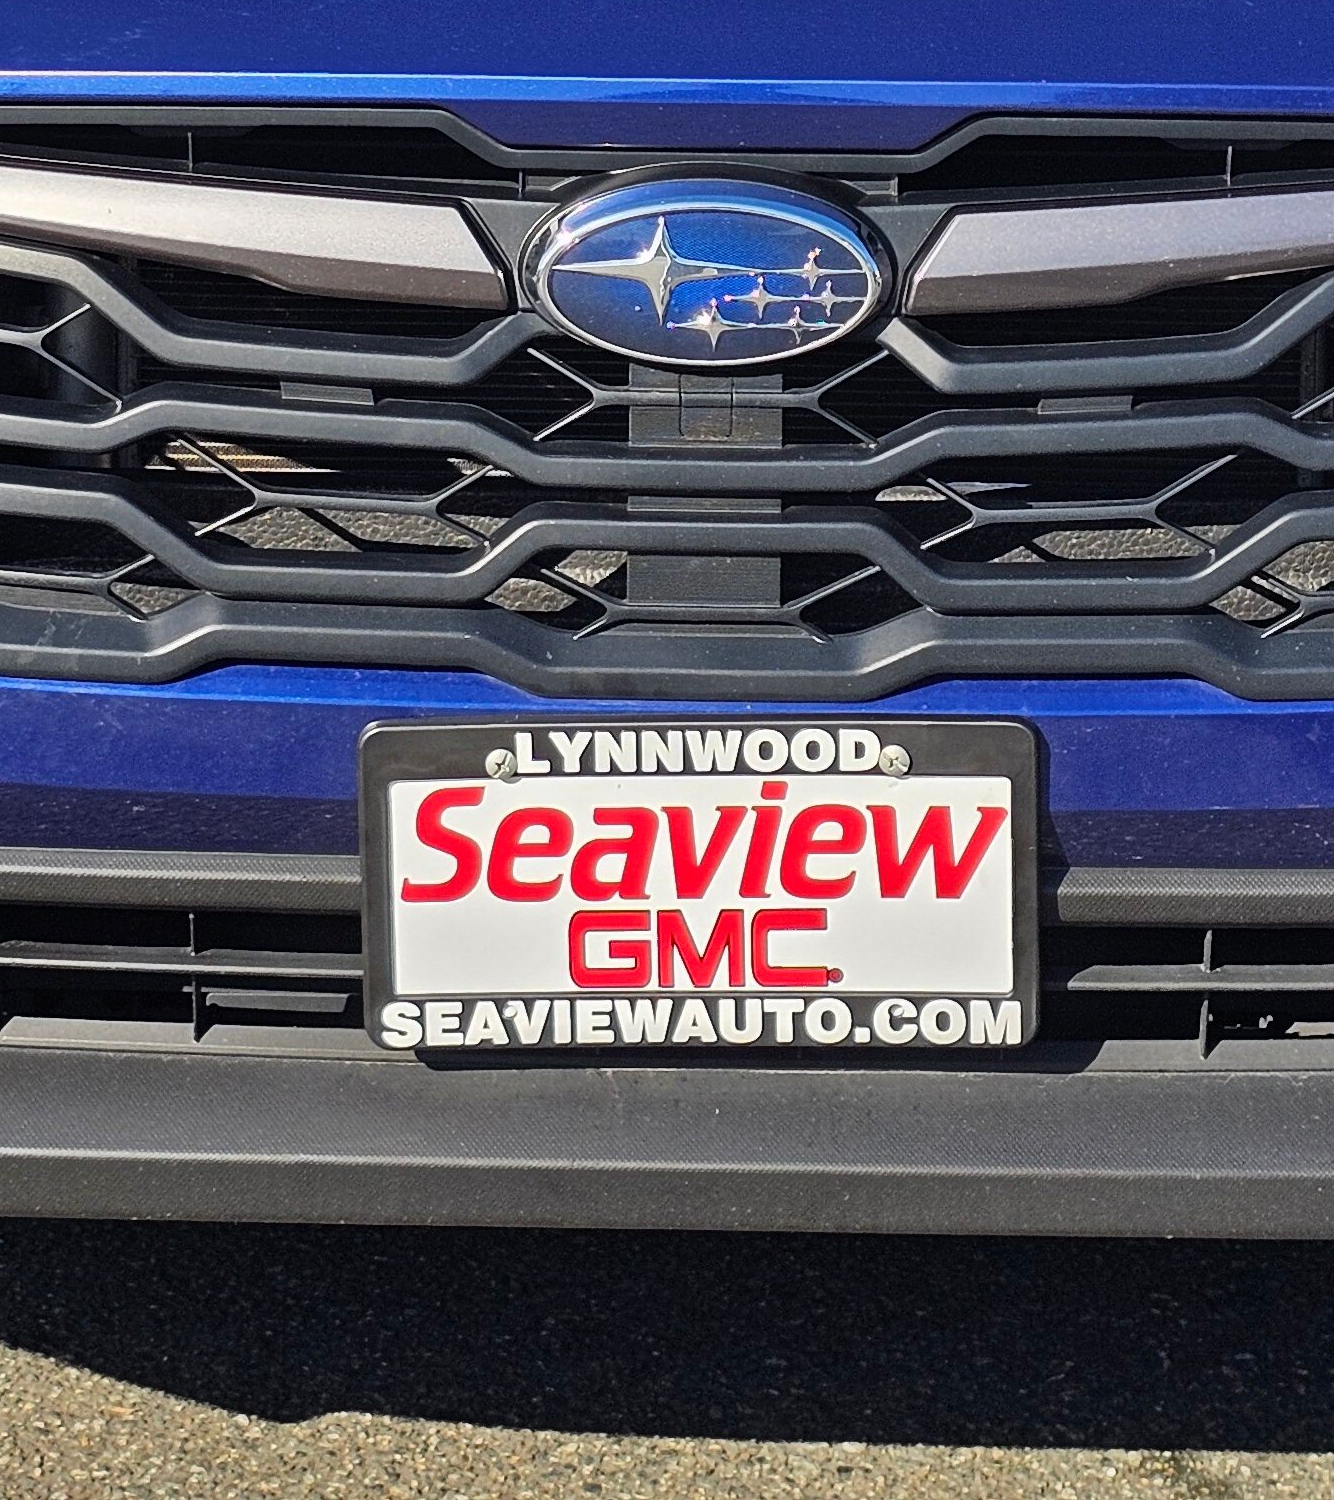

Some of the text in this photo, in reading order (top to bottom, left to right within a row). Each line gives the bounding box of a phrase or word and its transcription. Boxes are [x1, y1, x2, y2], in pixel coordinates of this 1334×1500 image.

[515, 729, 881, 774] LYNNWOOD
[400, 780, 1008, 903] Seaview
[568, 909, 830, 989] GMC
[380, 999, 1023, 1049] SEAVIEWAUTO.COM
